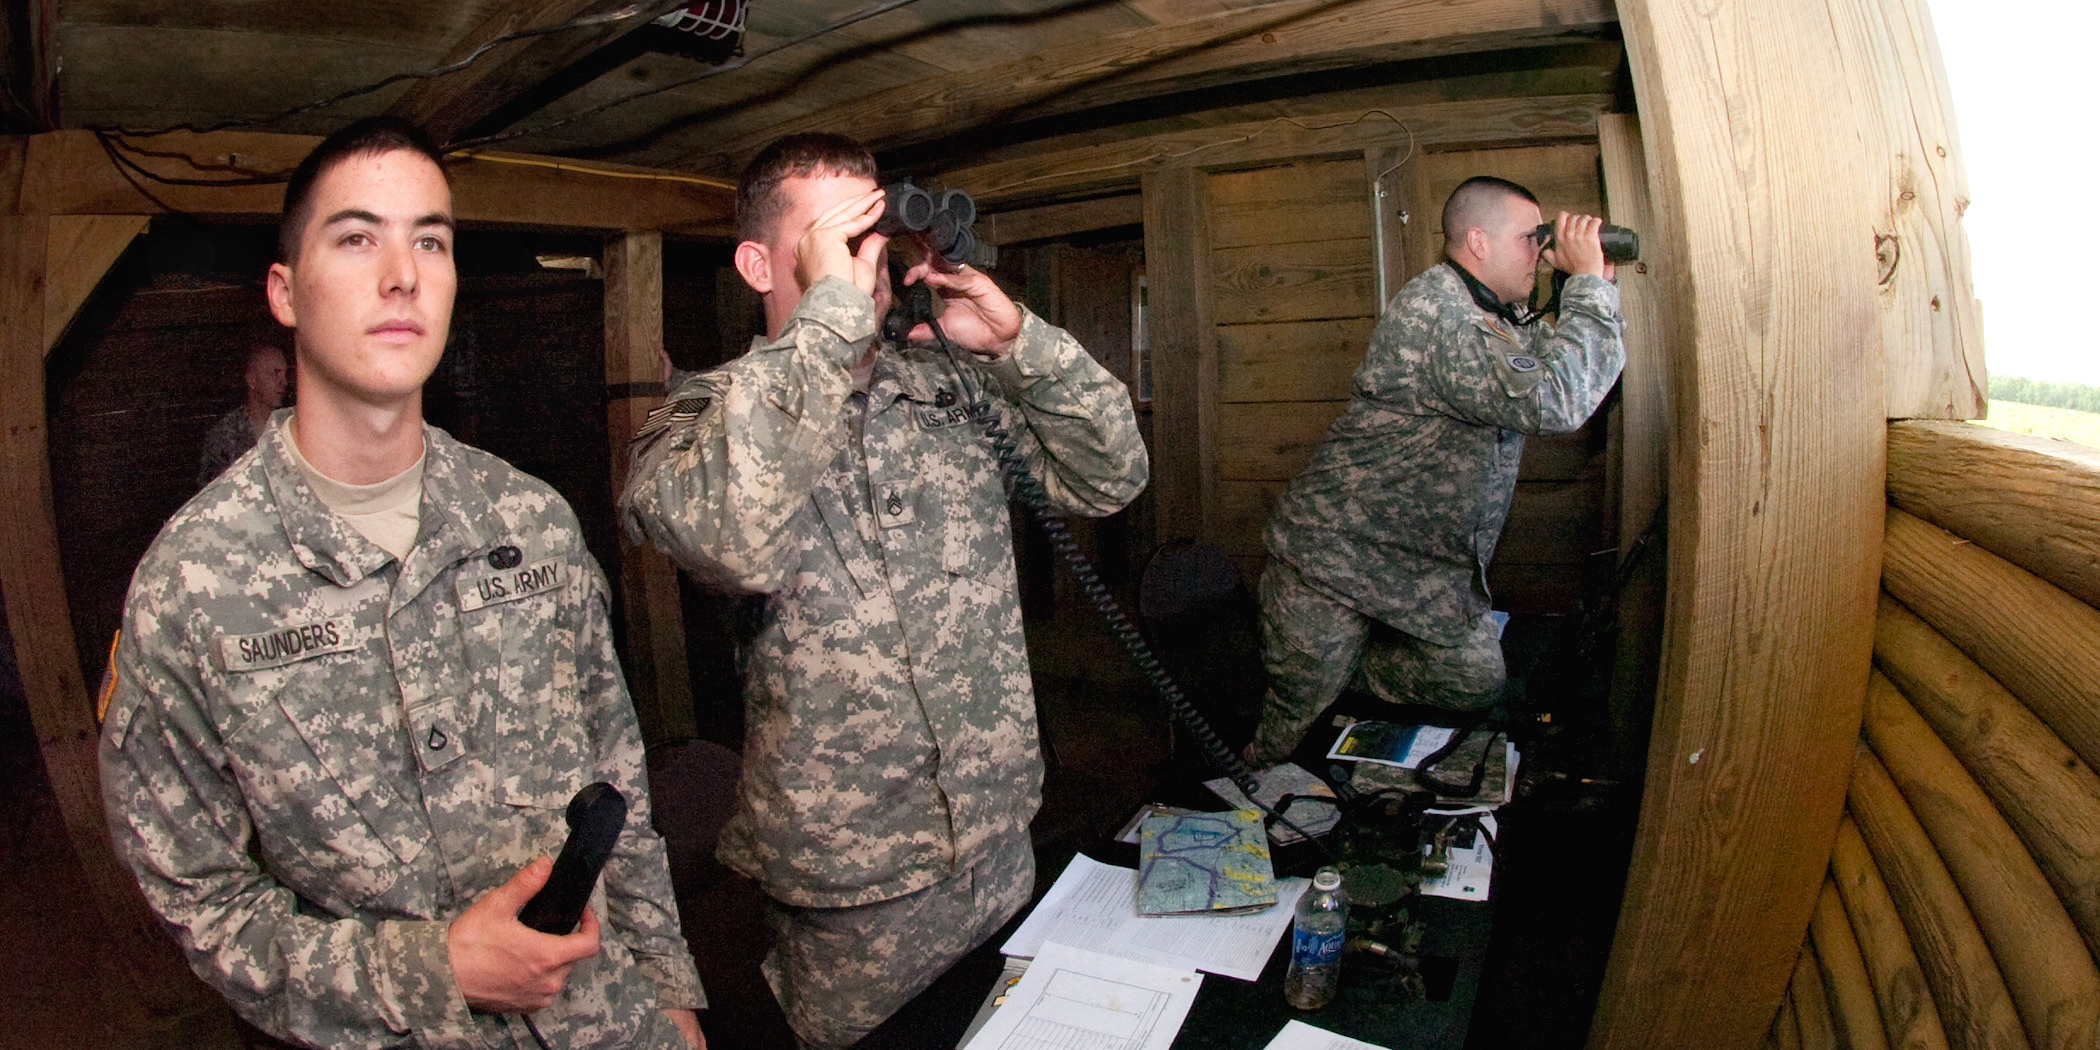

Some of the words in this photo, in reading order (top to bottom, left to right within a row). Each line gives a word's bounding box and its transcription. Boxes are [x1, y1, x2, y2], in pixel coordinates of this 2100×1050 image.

[920, 412, 945, 428] U.S.
[513, 562, 558, 594] ARMY
[239, 621, 339, 663] SAUNDERS
